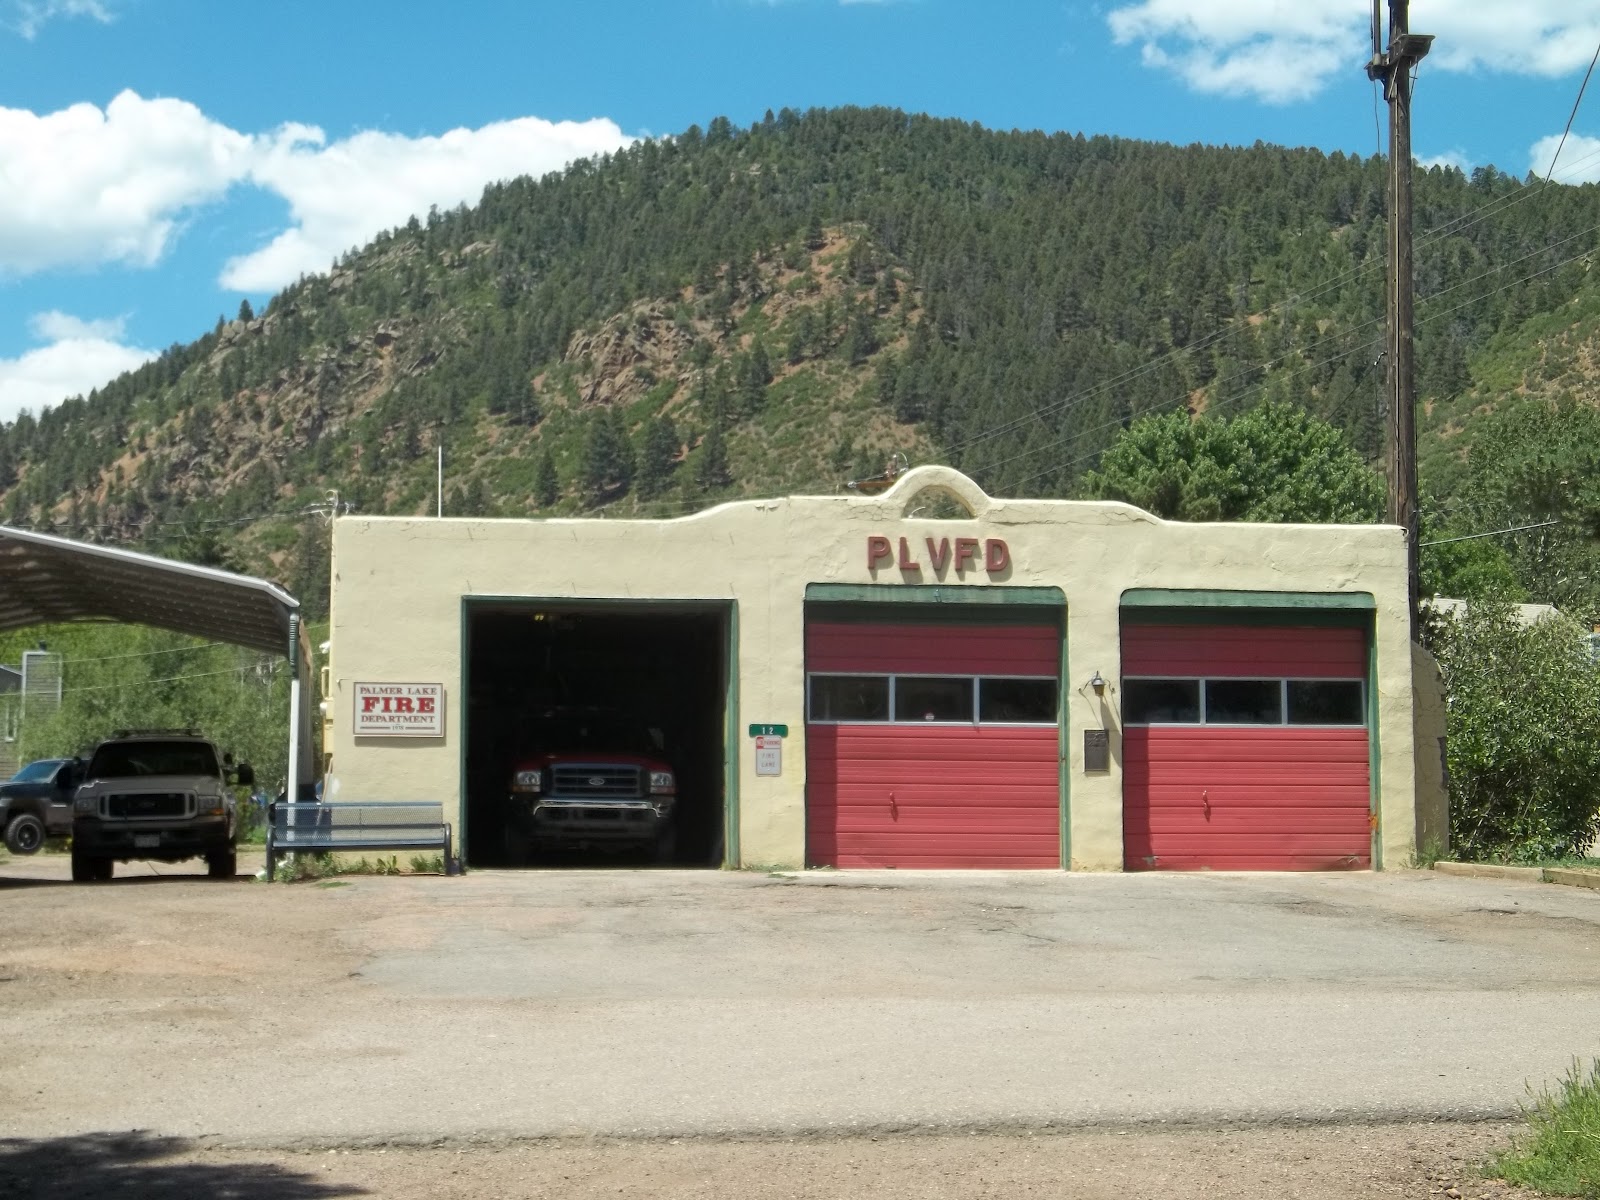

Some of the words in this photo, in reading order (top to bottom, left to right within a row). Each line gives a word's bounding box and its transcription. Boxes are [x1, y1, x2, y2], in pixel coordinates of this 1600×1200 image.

[868, 536, 1010, 571] PLVFD
[360, 687, 402, 695] PALMER
[362, 696, 435, 713] FIRE
[361, 715, 435, 723] DEPARTMENT
